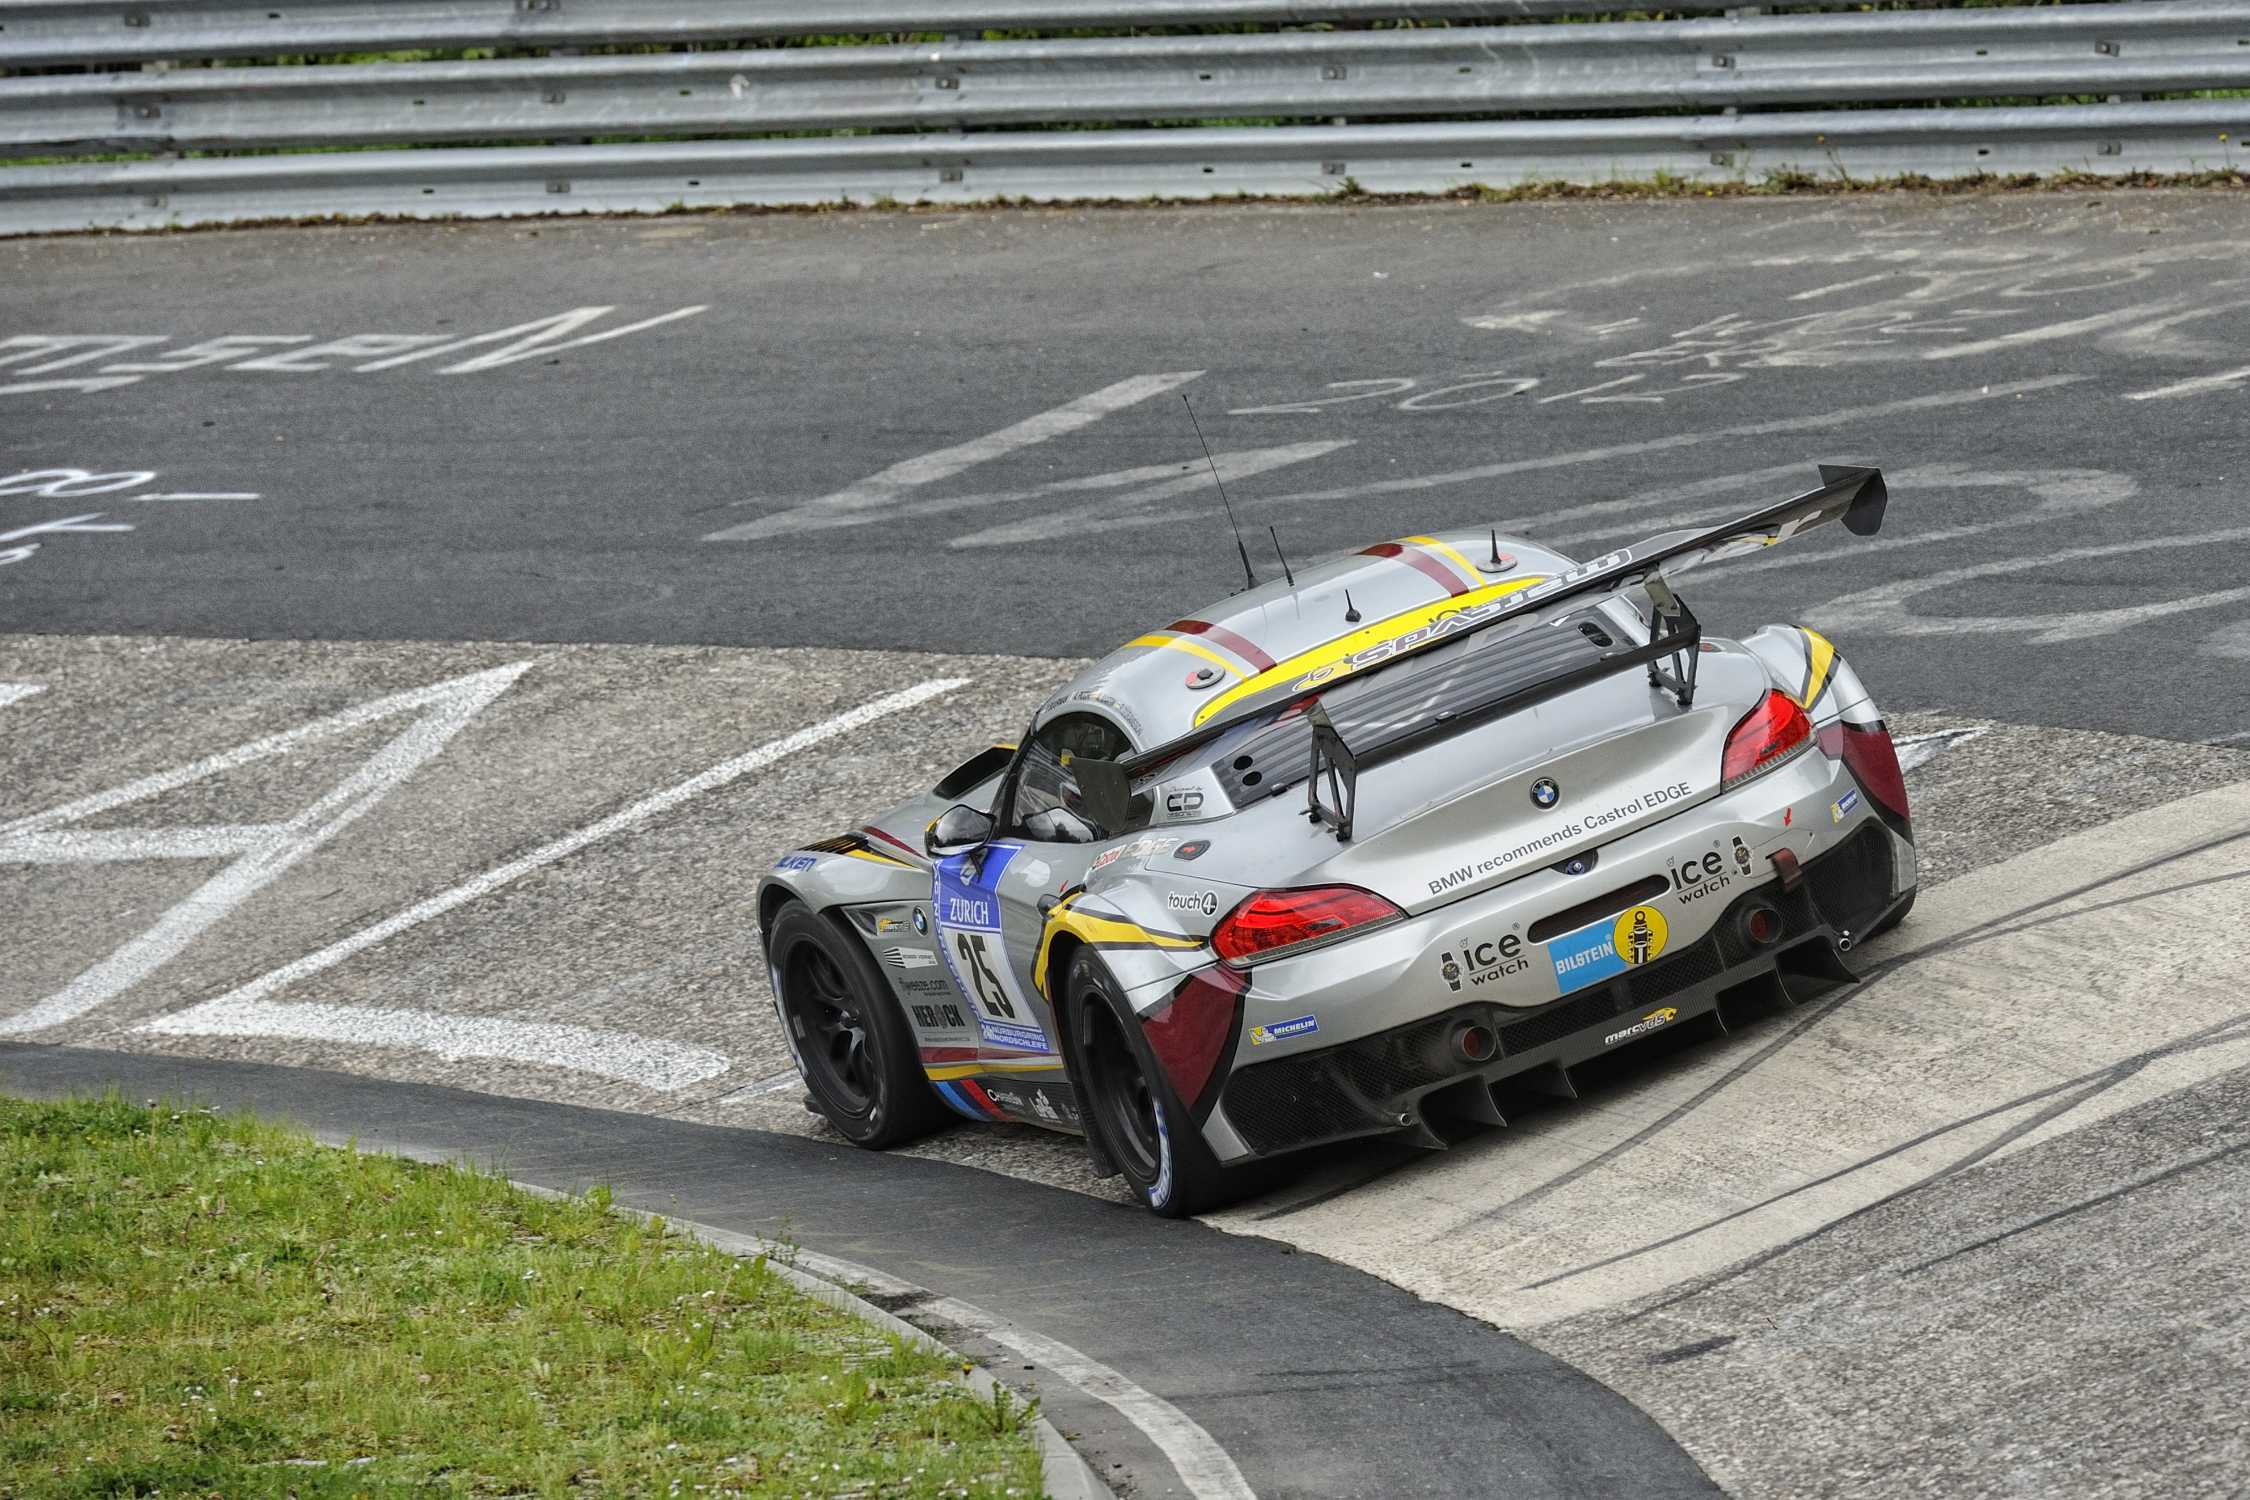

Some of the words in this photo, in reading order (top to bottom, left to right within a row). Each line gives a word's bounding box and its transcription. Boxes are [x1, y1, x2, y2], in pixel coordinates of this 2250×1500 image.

[1227, 370, 1746, 416] 2012
[1428, 864, 1475, 896] BMW
[1476, 824, 1583, 876] recommends
[1583, 798, 1643, 831] Castrol
[1644, 781, 1692, 809] EDGE
[1667, 851, 1722, 890] ice
[1678, 874, 1731, 906] watch
[950, 897, 990, 926] ZURICH
[1460, 933, 1521, 972] ice
[1555, 942, 1614, 975] BILSTEIN
[956, 932, 1016, 1019] 25
[1470, 958, 1530, 986] watch
[1273, 1019, 1315, 1035] MICHELIN
